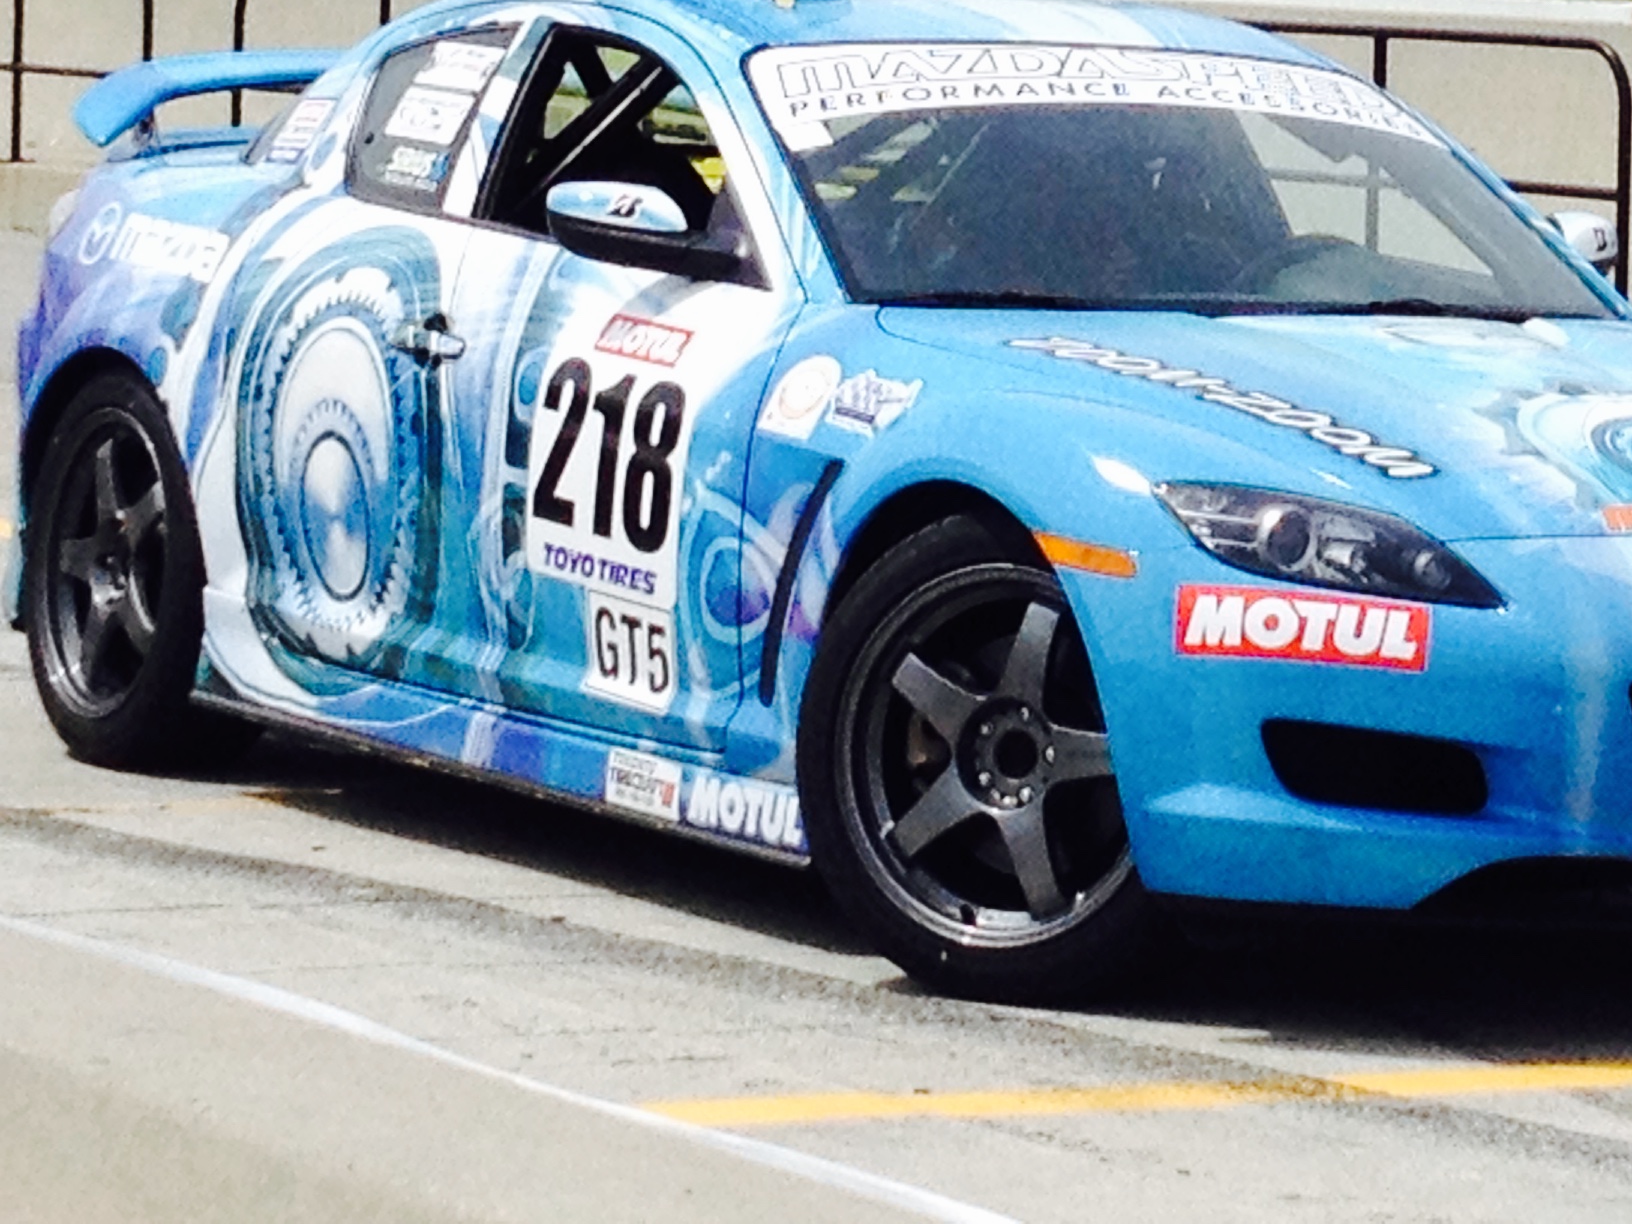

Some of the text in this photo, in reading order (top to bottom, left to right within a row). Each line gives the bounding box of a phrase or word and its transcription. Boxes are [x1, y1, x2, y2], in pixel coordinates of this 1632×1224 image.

[789, 80, 1130, 117] PERFORMANCE
[532, 356, 687, 554] 218
[543, 542, 658, 595] TOYO TIRES
[595, 606, 669, 694] GT5
[1184, 594, 1418, 661] MOTUL
[687, 776, 802, 846] MOTUL
